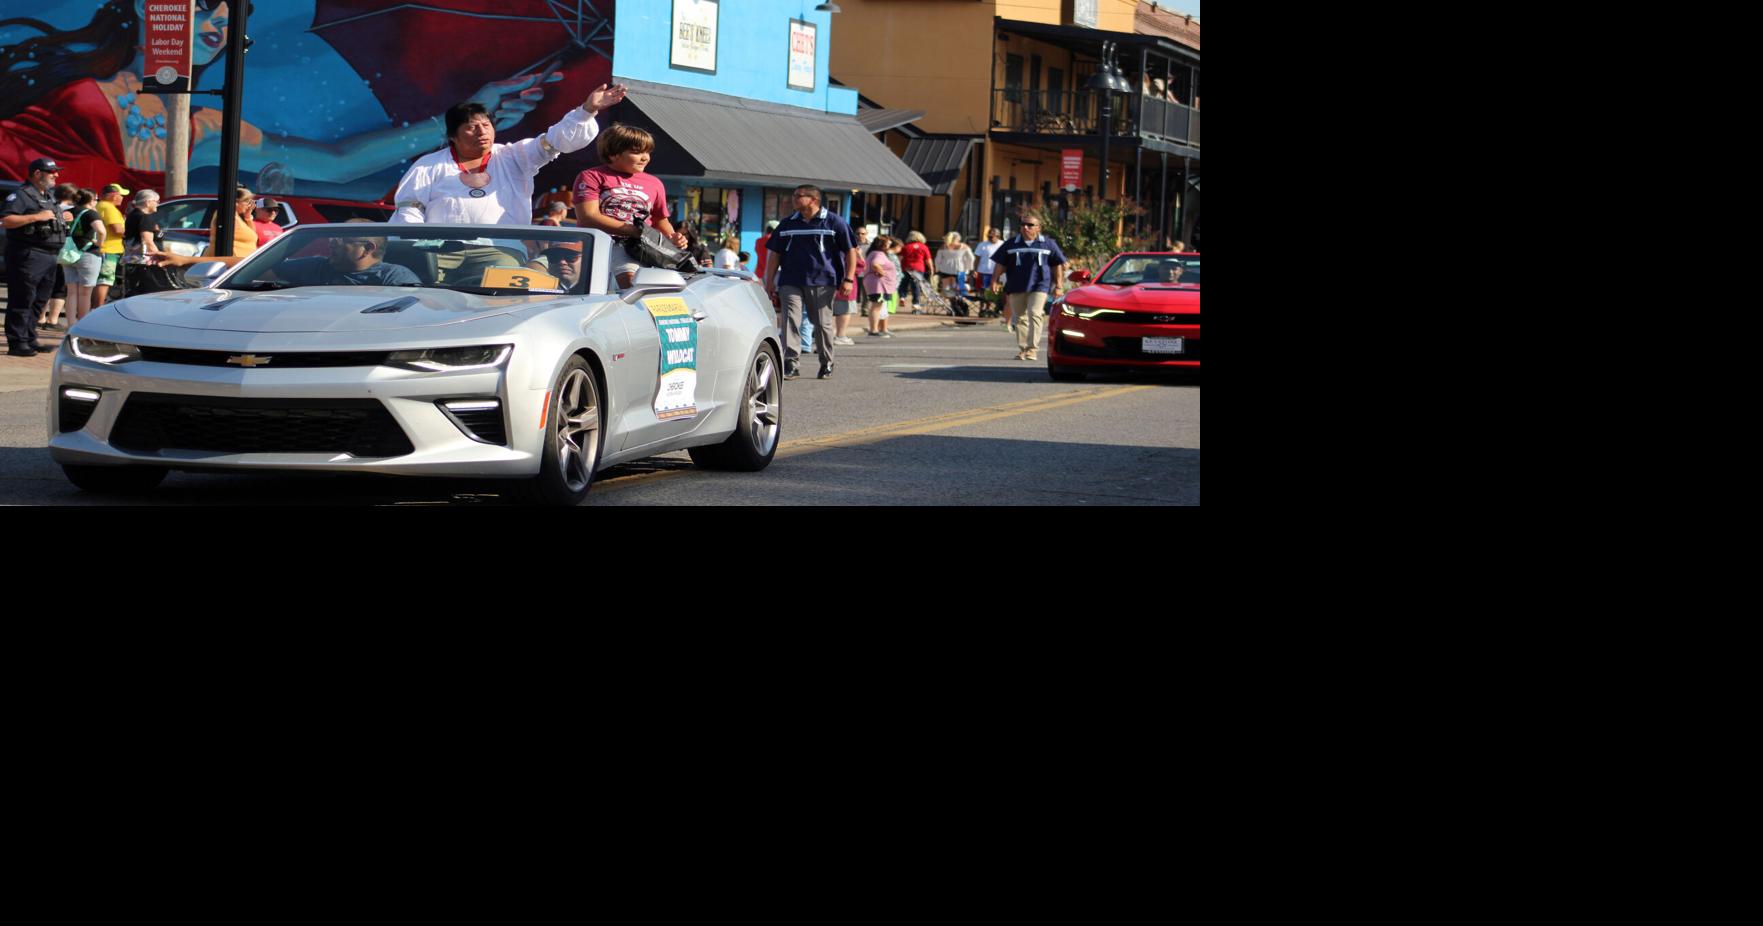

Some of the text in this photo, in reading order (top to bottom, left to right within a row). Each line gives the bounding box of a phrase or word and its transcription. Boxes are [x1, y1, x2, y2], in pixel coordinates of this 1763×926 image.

[149, 4, 187, 12] CHEROKEE
[150, 14, 186, 22] NATIONAL
[151, 38, 184, 47] Labor Day
[152, 48, 183, 56] Weekend
[509, 275, 530, 288] 3
[665, 327, 690, 342] TOMMY
[667, 348, 694, 365] WILDCAT
